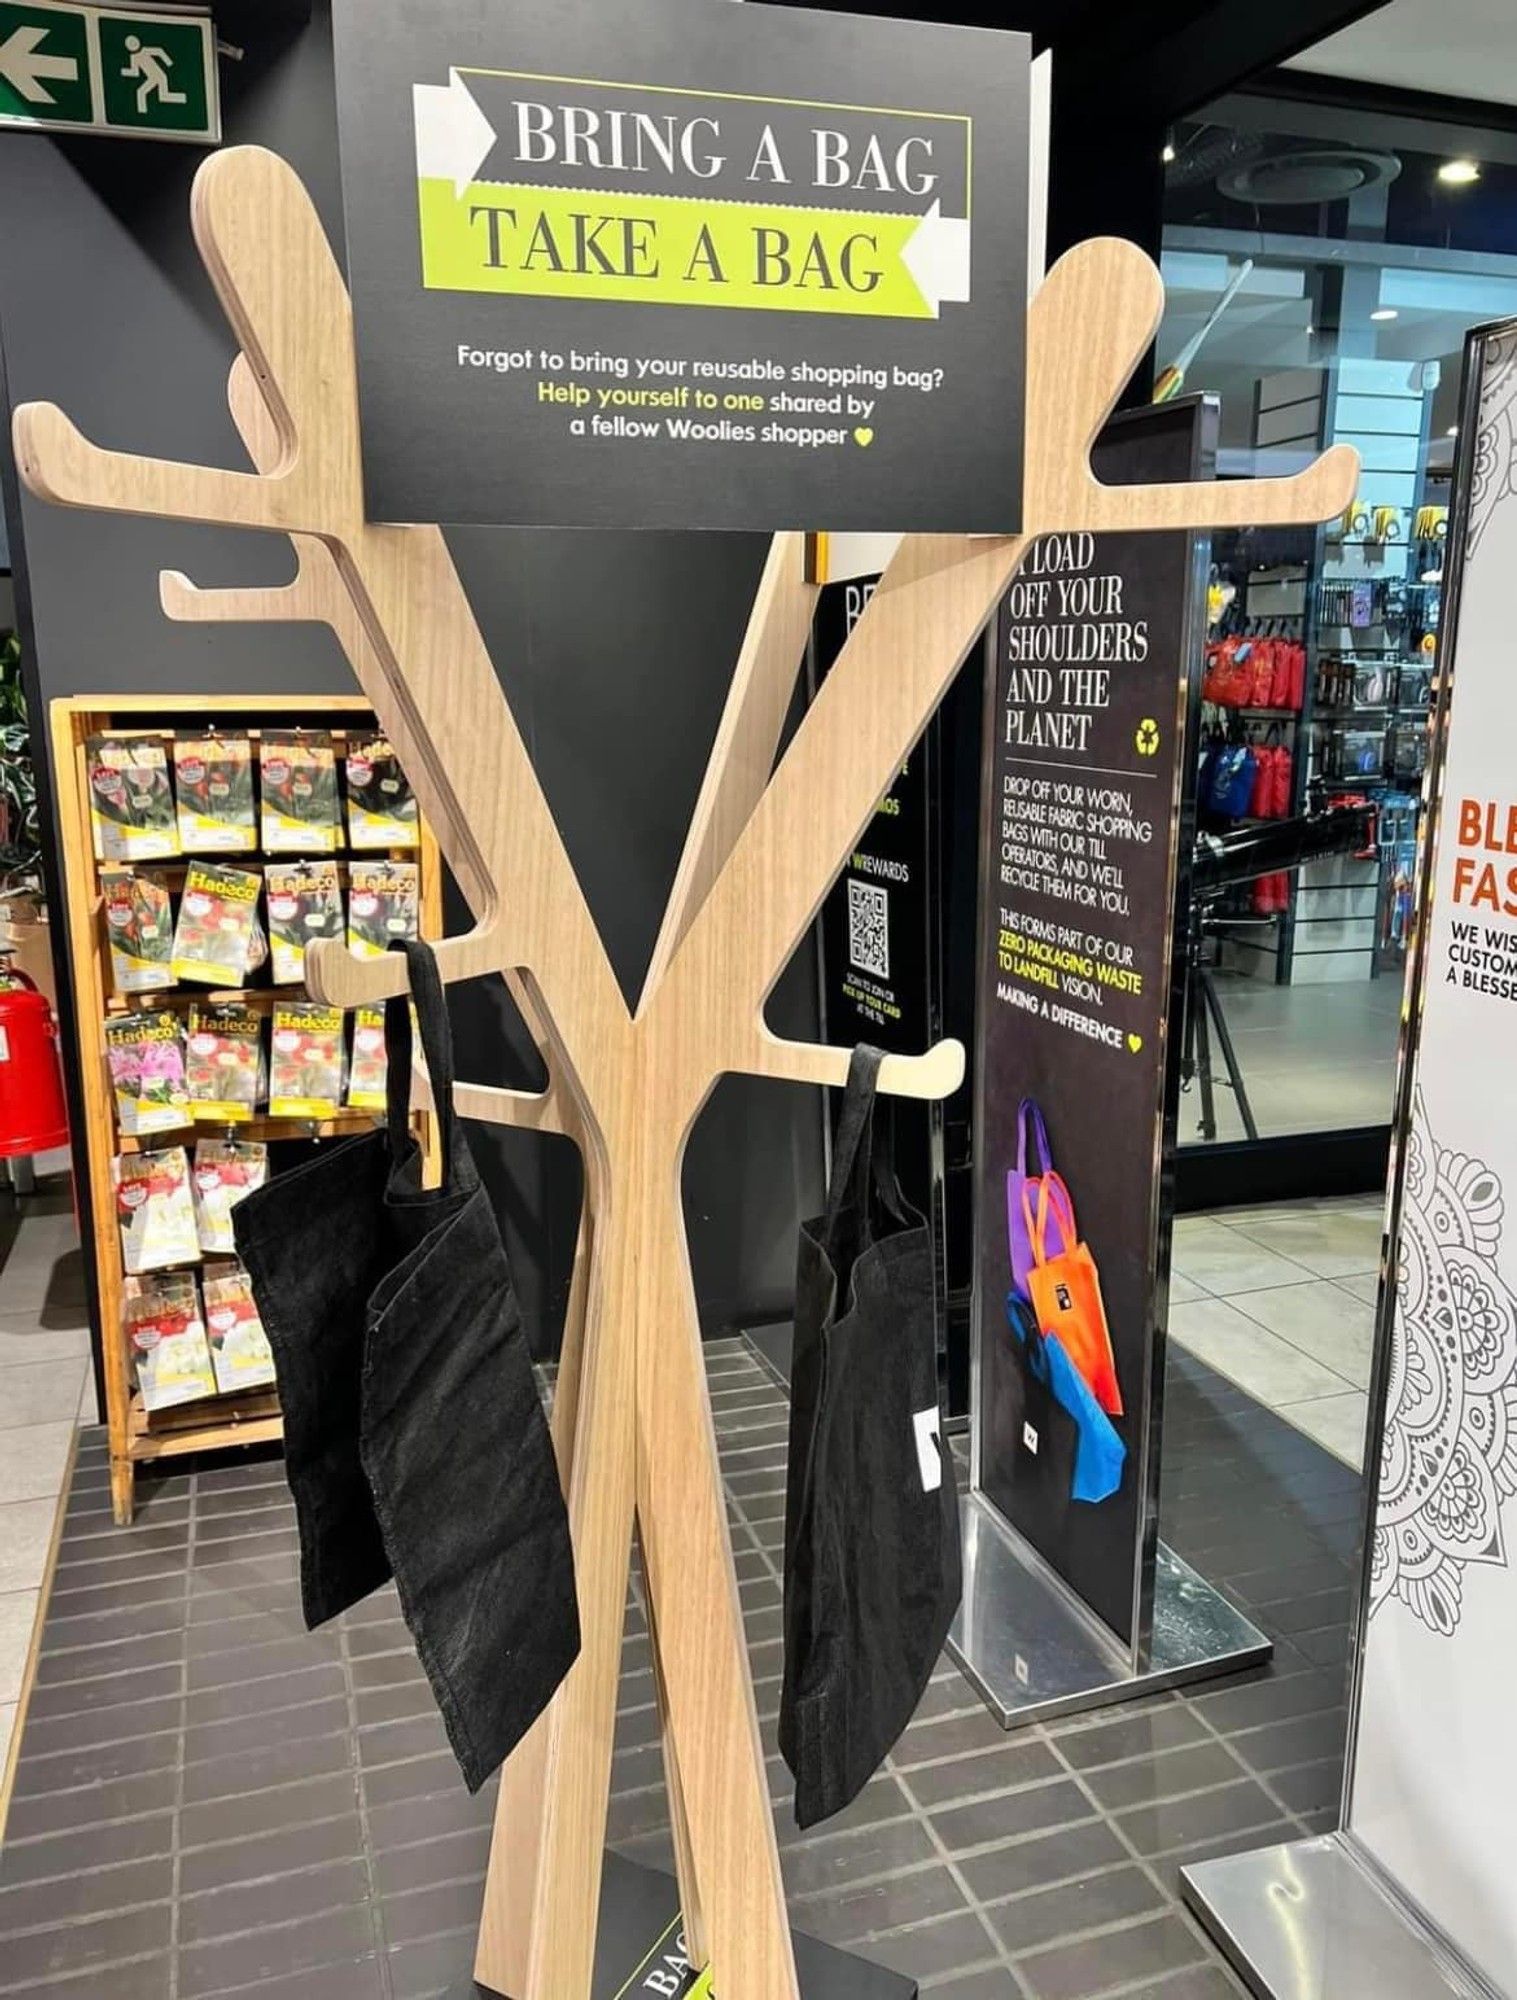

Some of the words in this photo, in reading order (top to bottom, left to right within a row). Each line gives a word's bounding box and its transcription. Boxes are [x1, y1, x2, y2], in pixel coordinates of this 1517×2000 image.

[511, 101, 728, 179] BRING
[747, 125, 792, 184] A
[810, 129, 939, 196] BAG
[470, 206, 660, 279] TAKE
[682, 223, 729, 284] A
[752, 228, 884, 293] BAG
[457, 344, 533, 373] Forgot
[540, 349, 564, 370] to
[570, 350, 630, 379] bring
[635, 358, 687, 379] your
[692, 358, 786, 381] reusable
[790, 361, 888, 390] shopping
[893, 365, 944, 391] bag?
[538, 381, 591, 408] Help
[597, 386, 689, 409] yourself
[694, 389, 718, 409] to
[723, 393, 765, 411] one
[769, 390, 841, 414] shared
[847, 394, 876, 419] by
[570, 418, 585, 436] a
[591, 414, 660, 438] fellow
[666, 419, 756, 442] Woolies
[761, 421, 849, 448] shopper
[1031, 532, 1095, 575] LOAD
[1010, 580, 1051, 619] OFF
[1057, 575, 1123, 617] YOUR
[1008, 621, 1149, 662] SHOULDERS
[1005, 668, 1053, 704] AND
[1059, 669, 1110, 707] THE
[1005, 709, 1093, 751] PLANET
[1003, 775, 1030, 797] DROP
[1031, 779, 1051, 800] OFF
[1053, 783, 1084, 806] YOUR
[1087, 787, 1133, 817] WORN,
[1002, 820, 1029, 842] BAGS
[1030, 826, 1058, 848] WITH
[1060, 832, 1085, 855] OUR
[1088, 837, 1107, 860] TILL
[1003, 798, 1047, 824] REUSABLE
[1048, 805, 1084, 831] FABRIC
[1086, 812, 1152, 842] SHOPPING
[1001, 843, 1059, 876] OPERATORS,
[1061, 857, 1088, 880] AND
[1001, 864, 1040, 892] RECYCLE
[1042, 875, 1072, 900] THEM
[1074, 884, 1097, 908] FOR
[1100, 889, 1130, 917] YOU.
[1000, 907, 1019, 930] THIS
[1020, 914, 1056, 942] FORMS
[1057, 926, 1083, 950] PART
[1085, 933, 1103, 956] OF
[1104, 941, 1133, 967] OUR
[1451, 921, 1478, 944] WE
[999, 929, 1026, 954] ZERO
[1027, 938, 1093, 978] PACKAGING
[1096, 961, 1142, 995] WASTE
[999, 950, 1012, 971] TO
[1014, 957, 1059, 989] LANDFILL
[1061, 973, 1103, 1006] VISION.
[1446, 965, 1457, 985] A
[1448, 943, 1517, 977] CUSTOM
[108, 1026, 173, 1045] Hadeco
[191, 1013, 258, 1033] Hadeco
[276, 1011, 340, 1030] Hadeco
[997, 982, 1039, 1015] MAKING
[1040, 1000, 1050, 1019] A
[1051, 1003, 1123, 1049] DIFFERENCE
